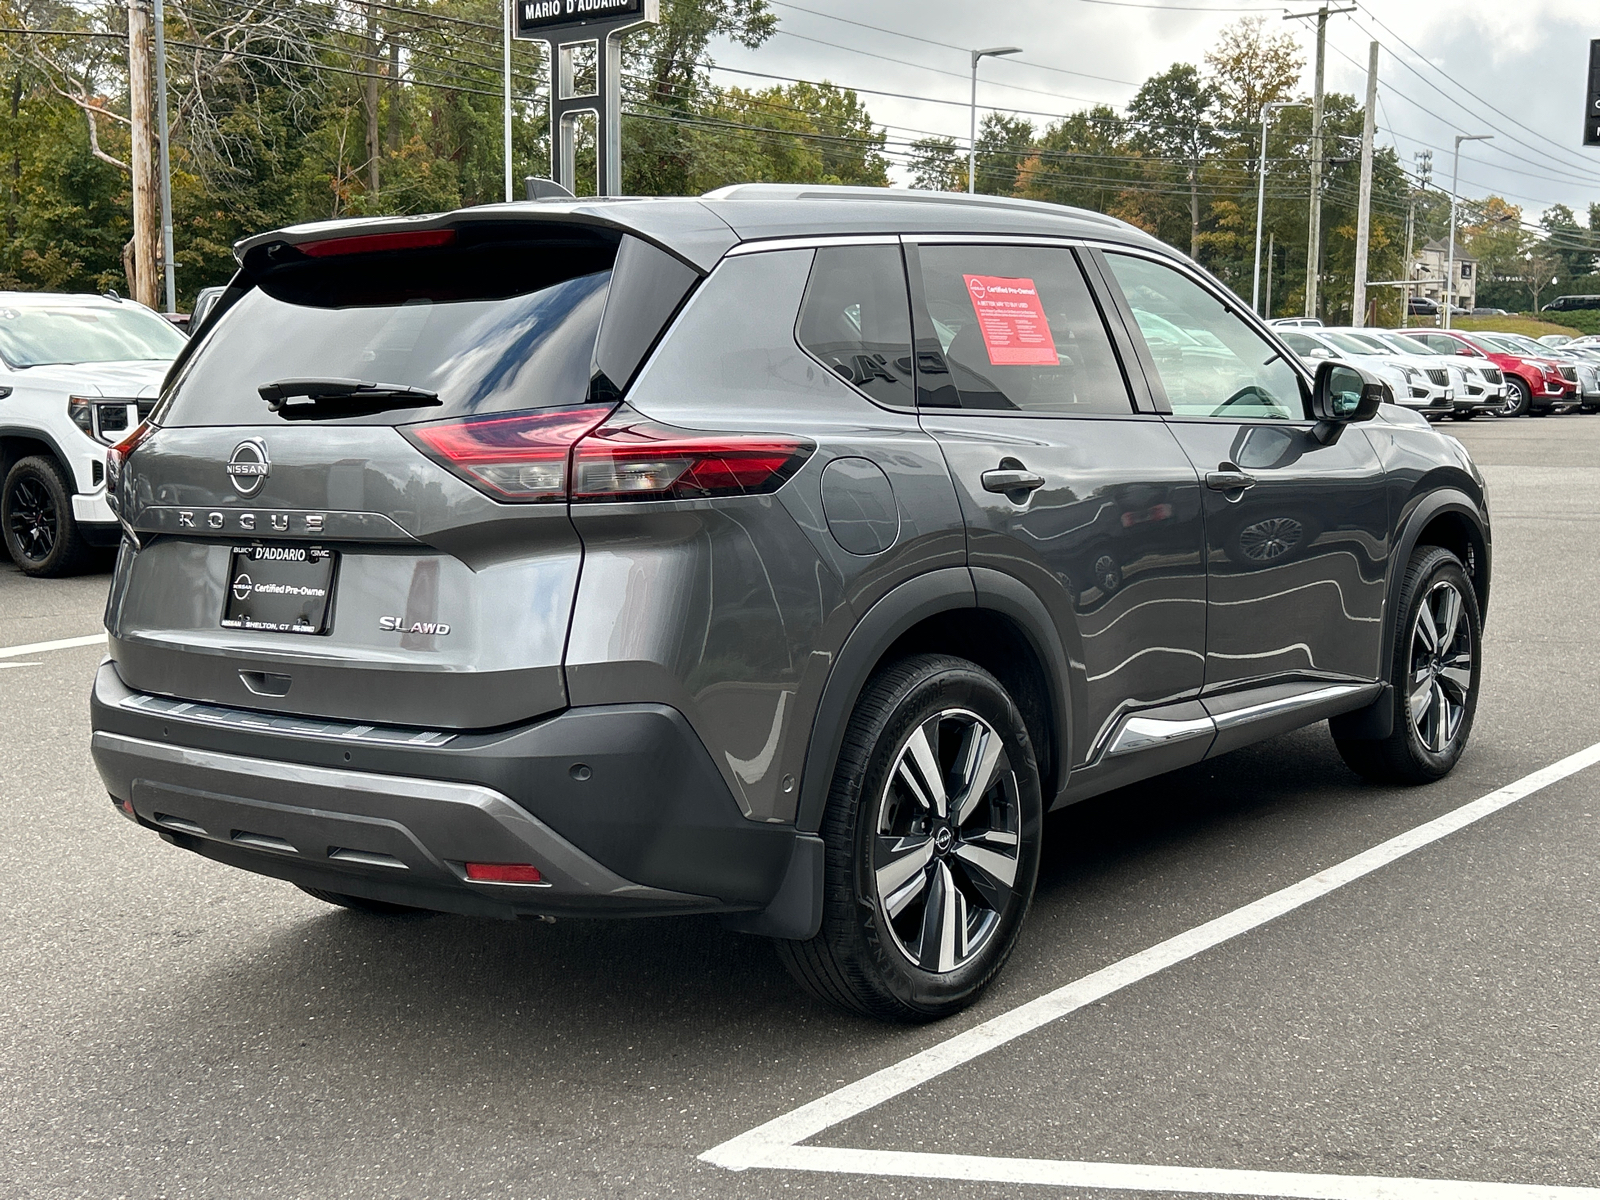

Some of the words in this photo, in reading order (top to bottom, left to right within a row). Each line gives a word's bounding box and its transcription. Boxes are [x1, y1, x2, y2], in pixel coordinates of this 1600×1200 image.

[525, 0, 560, 20] MARIO
[226, 464, 267, 475] NISSAN
[179, 511, 325, 532] ROGUE
[255, 547, 306, 561] D'ADDARIO
[254, 583, 285, 595] Certified
[245, 621, 278, 630] SHELTON,
[279, 623, 290, 631] CT
[379, 616, 411, 633] SL
[411, 622, 451, 636] AWD
